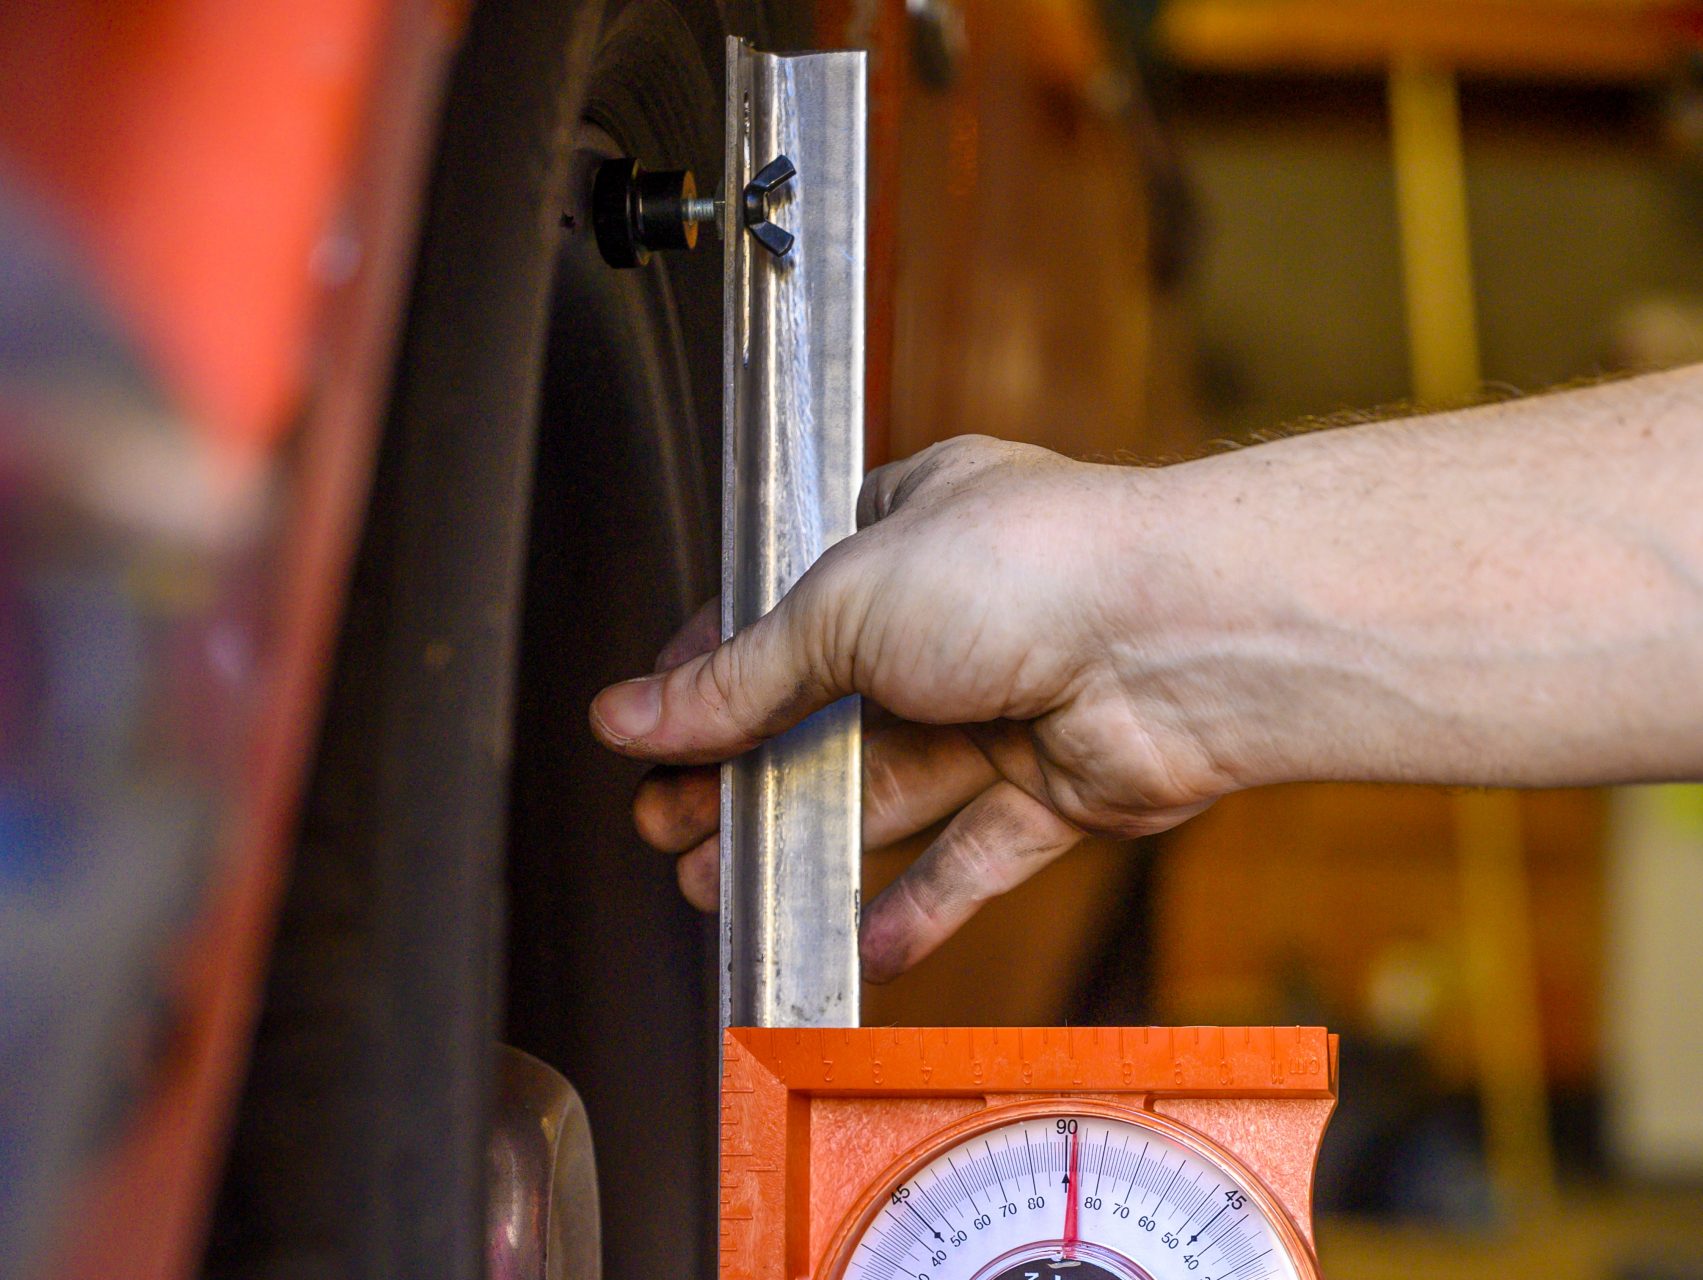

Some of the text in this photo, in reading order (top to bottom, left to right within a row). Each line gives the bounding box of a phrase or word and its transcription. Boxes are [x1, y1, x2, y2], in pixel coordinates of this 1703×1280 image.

[1056, 1119, 1078, 1135] 90
[890, 1184, 911, 1207] 45
[1027, 1196, 1045, 1211] 80
[1084, 1196, 1102, 1211] 80
[1224, 1189, 1247, 1211] 45
[999, 1203, 1017, 1218] 70
[1112, 1203, 1130, 1219] 70
[974, 1214, 991, 1231] 60
[1138, 1215, 1156, 1232] 60
[950, 1230, 968, 1248] 50
[1161, 1231, 1179, 1250] 50
[930, 1250, 947, 1268] 40
[1183, 1253, 1200, 1271] 40
